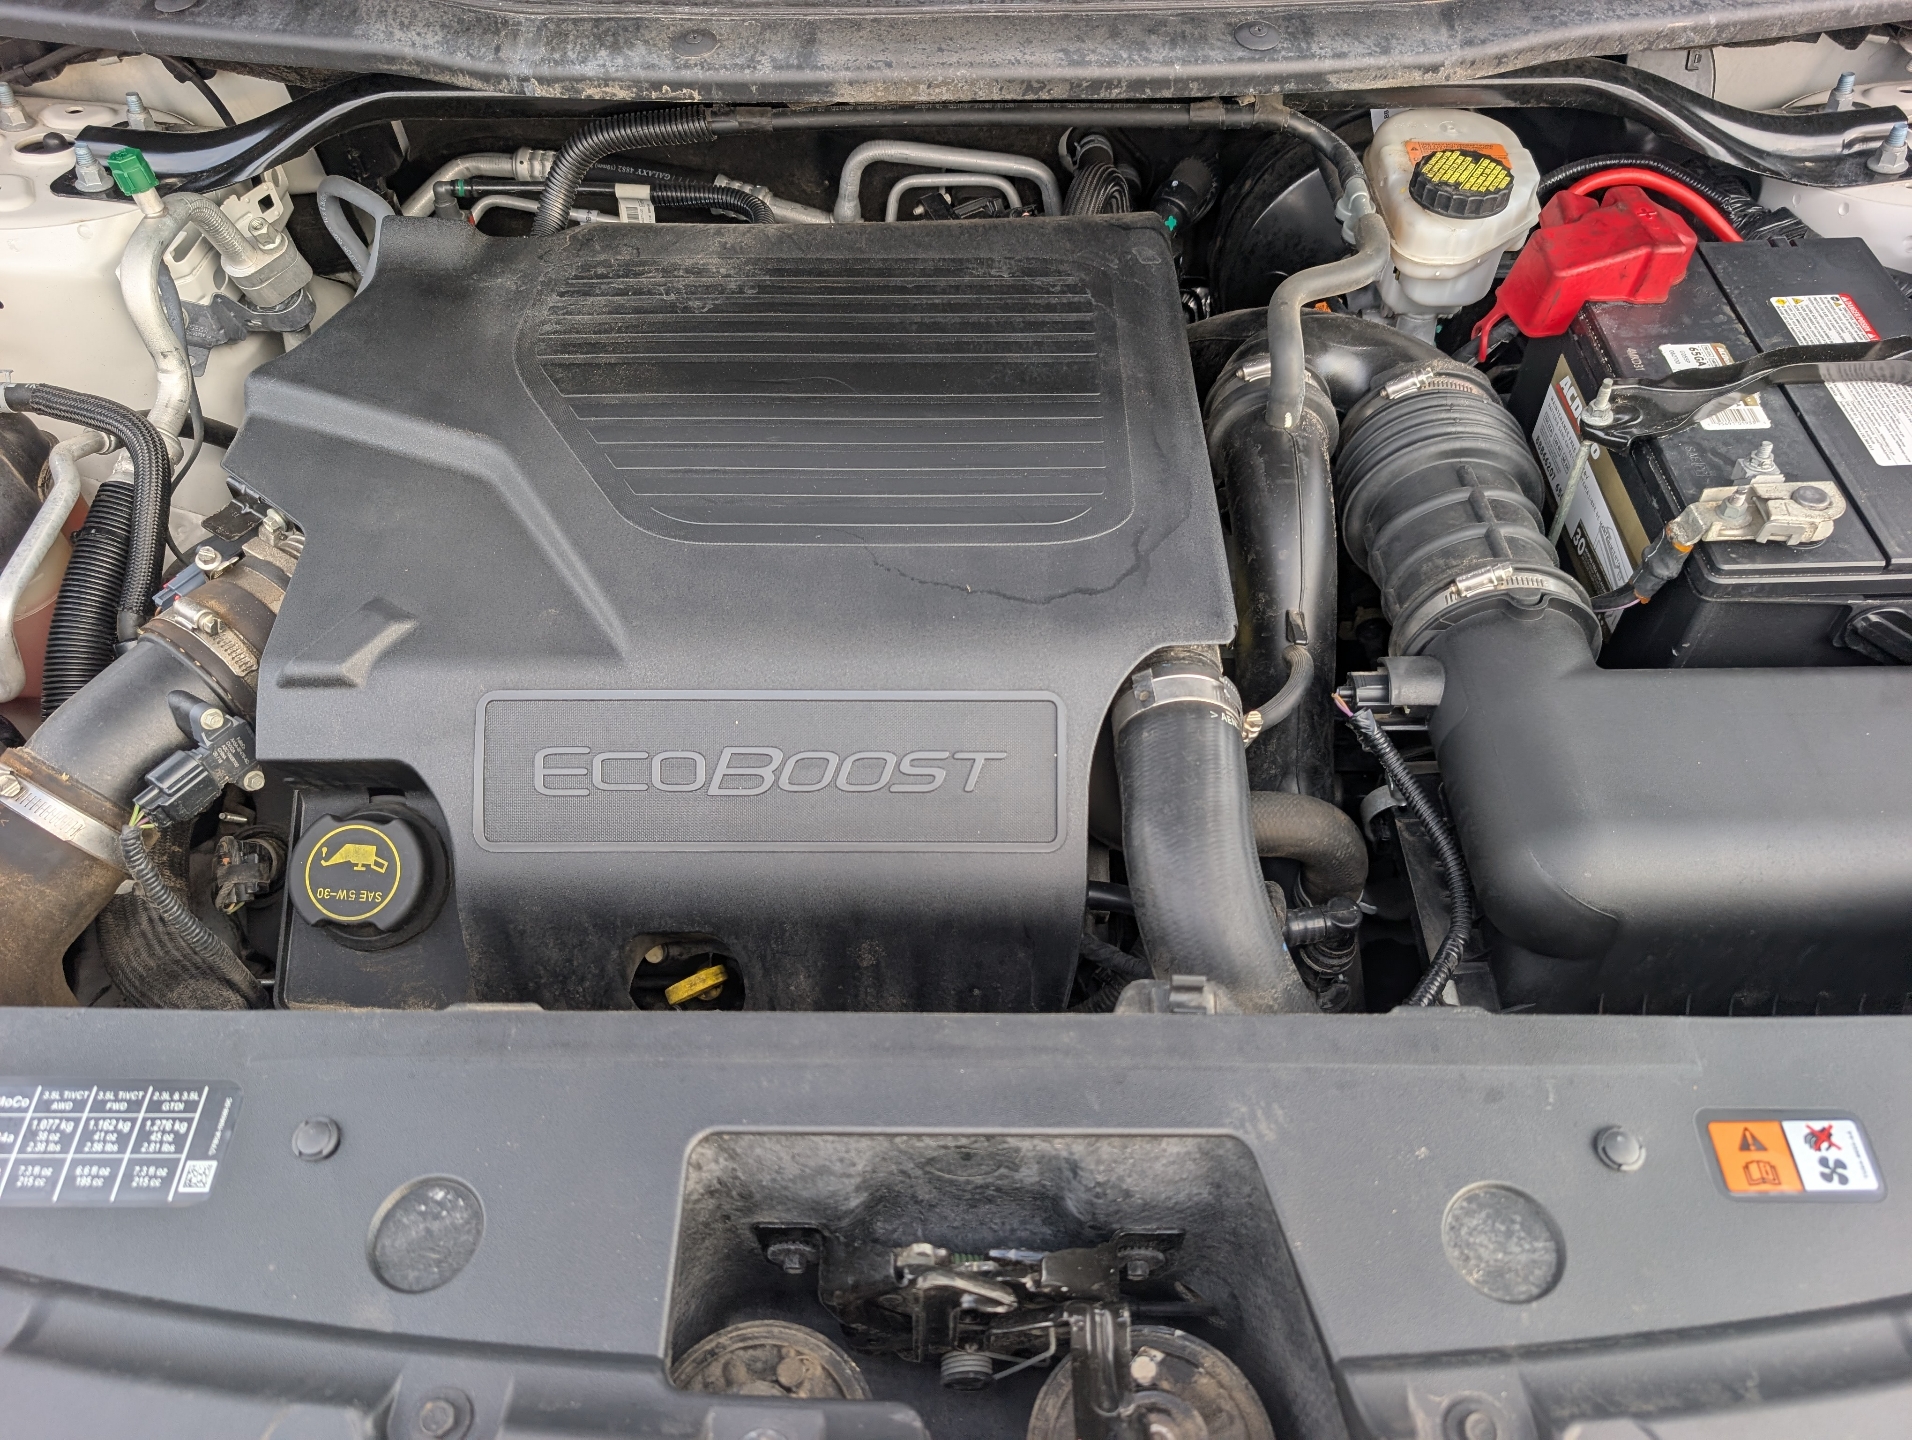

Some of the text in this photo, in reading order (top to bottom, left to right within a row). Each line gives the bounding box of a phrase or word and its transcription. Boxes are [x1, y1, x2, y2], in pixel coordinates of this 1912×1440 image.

[634, 168, 671, 181] GALAXY
[1573, 528, 1586, 555] 30
[317, 888, 383, 902] SAE 5W-30
[50, 1101, 73, 1111] AWD
[106, 1101, 128, 1111] FWD
[32, 1118, 75, 1134] 1.077 kg
[89, 1118, 132, 1134] 1.162 kg
[146, 1118, 188, 1134] 1.276 kg
[49, 1133, 61, 1141] oz
[93, 1132, 118, 1141] 41 oz
[163, 1133, 175, 1142] oz
[47, 1142, 61, 1152] lbs
[103, 1142, 119, 1152] lbs
[160, 1142, 175, 1152] lbs
[18, 1166, 31, 1176] 7.3
[41, 1167, 53, 1176] oz
[75, 1166, 89, 1176] 6.6
[99, 1167, 111, 1176] oz
[134, 1166, 148, 1176] 7.3
[156, 1167, 168, 1177] oz
